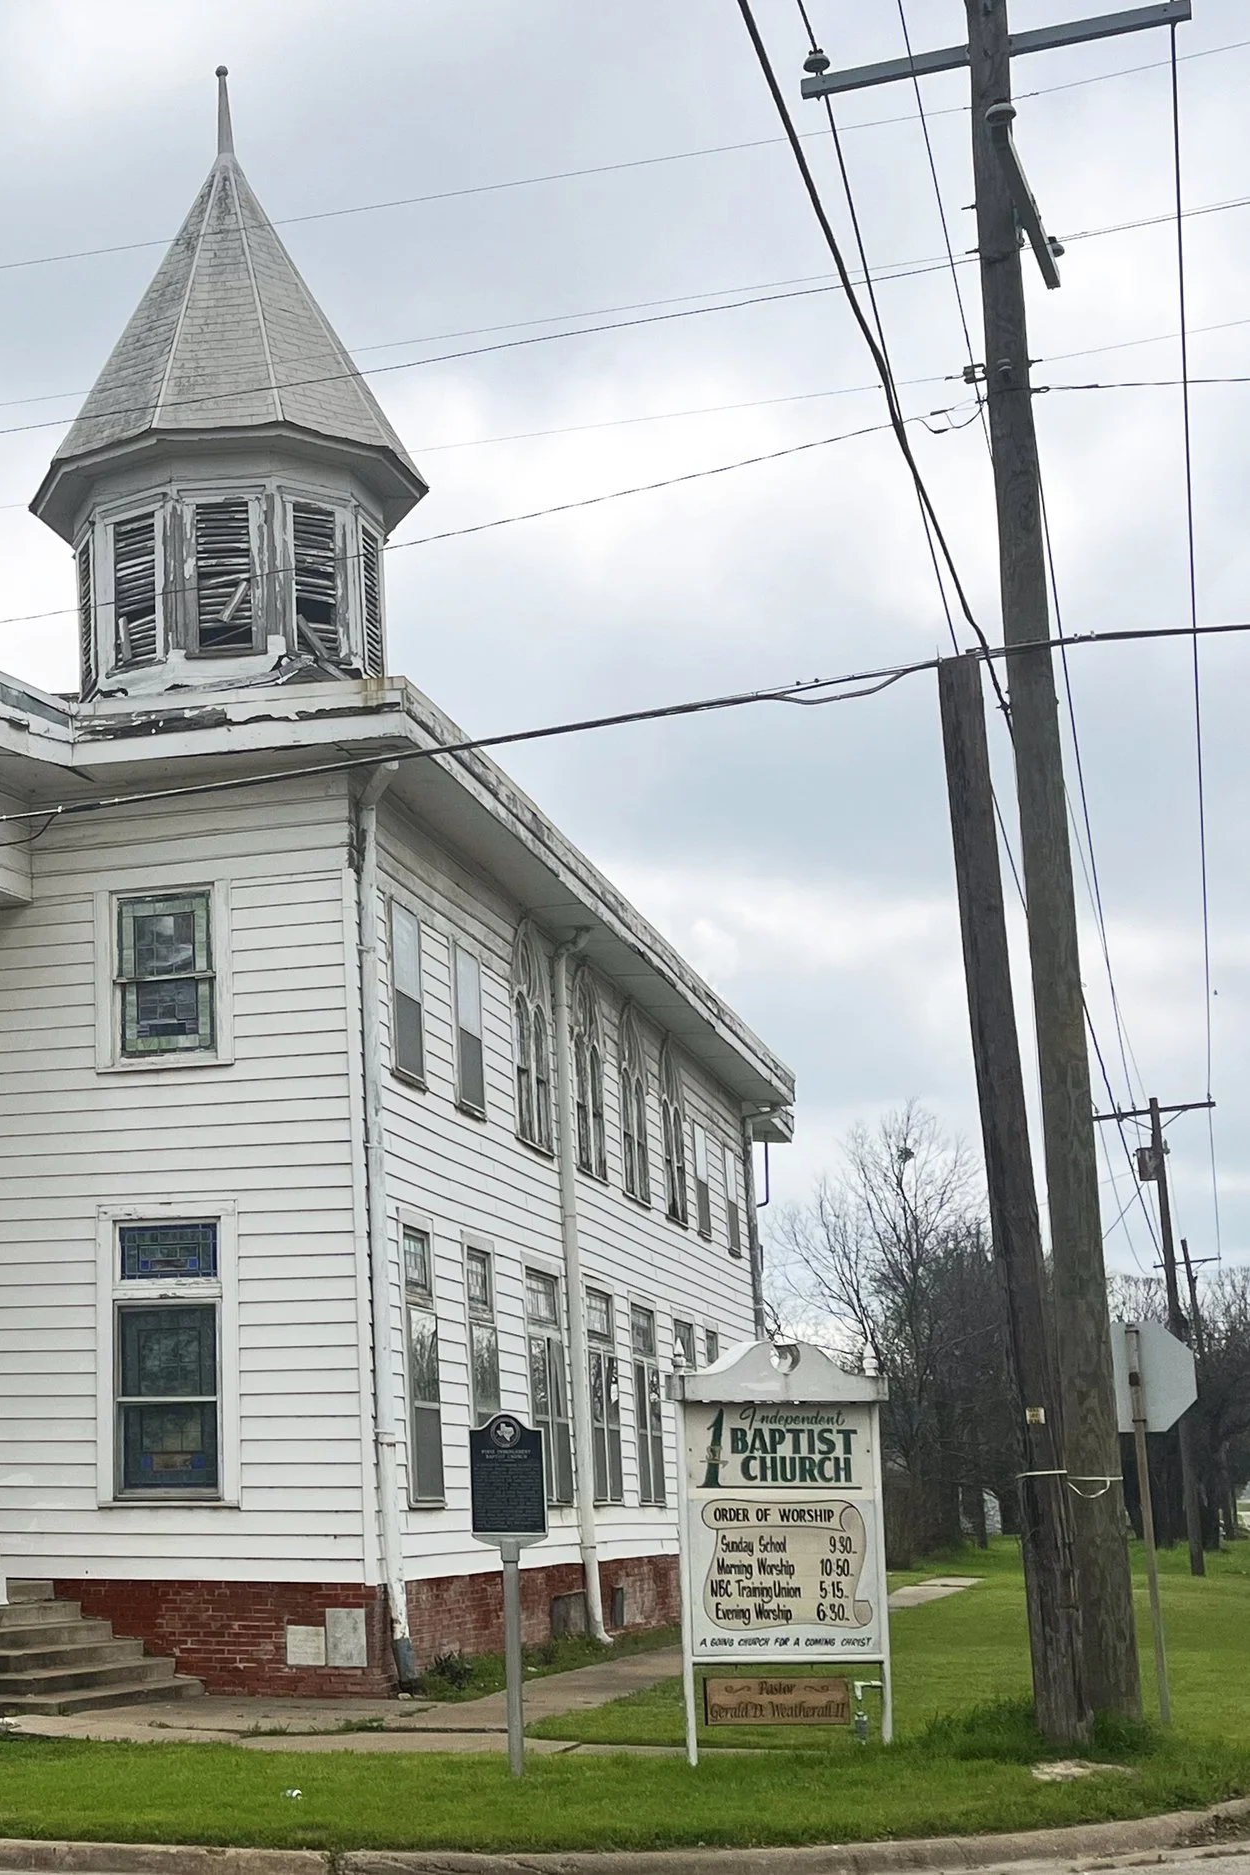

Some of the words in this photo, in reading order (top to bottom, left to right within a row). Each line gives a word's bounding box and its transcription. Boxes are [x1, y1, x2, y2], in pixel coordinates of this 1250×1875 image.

[739, 1406, 845, 1429] Independent
[730, 1427, 858, 1455] BAPTIST
[740, 1456, 853, 1483] CHURCH
[713, 1507, 750, 1522] ORDER
[755, 1508, 771, 1522] OF
[778, 1508, 835, 1523] WORSHIP
[720, 1534, 754, 1557] Sunday
[758, 1535, 787, 1554] School
[716, 1557, 754, 1580] Morning
[757, 1558, 795, 1580] Worship
[710, 1579, 733, 1598] NBC
[735, 1579, 773, 1604] Training
[773, 1580, 801, 1598] Union
[715, 1602, 751, 1626] Evening
[754, 1602, 793, 1624] Worship
[700, 1638, 708, 1647] A
[710, 1638, 734, 1647] GOING
[738, 1638, 770, 1647] CHURCH
[774, 1638, 790, 1647] FOR
[793, 1638, 800, 1647] A
[805, 1638, 836, 1647] COMING
[841, 1637, 872, 1647] CHRIST
[758, 1680, 797, 1696] Pastor
[710, 1701, 750, 1722] Gerald
